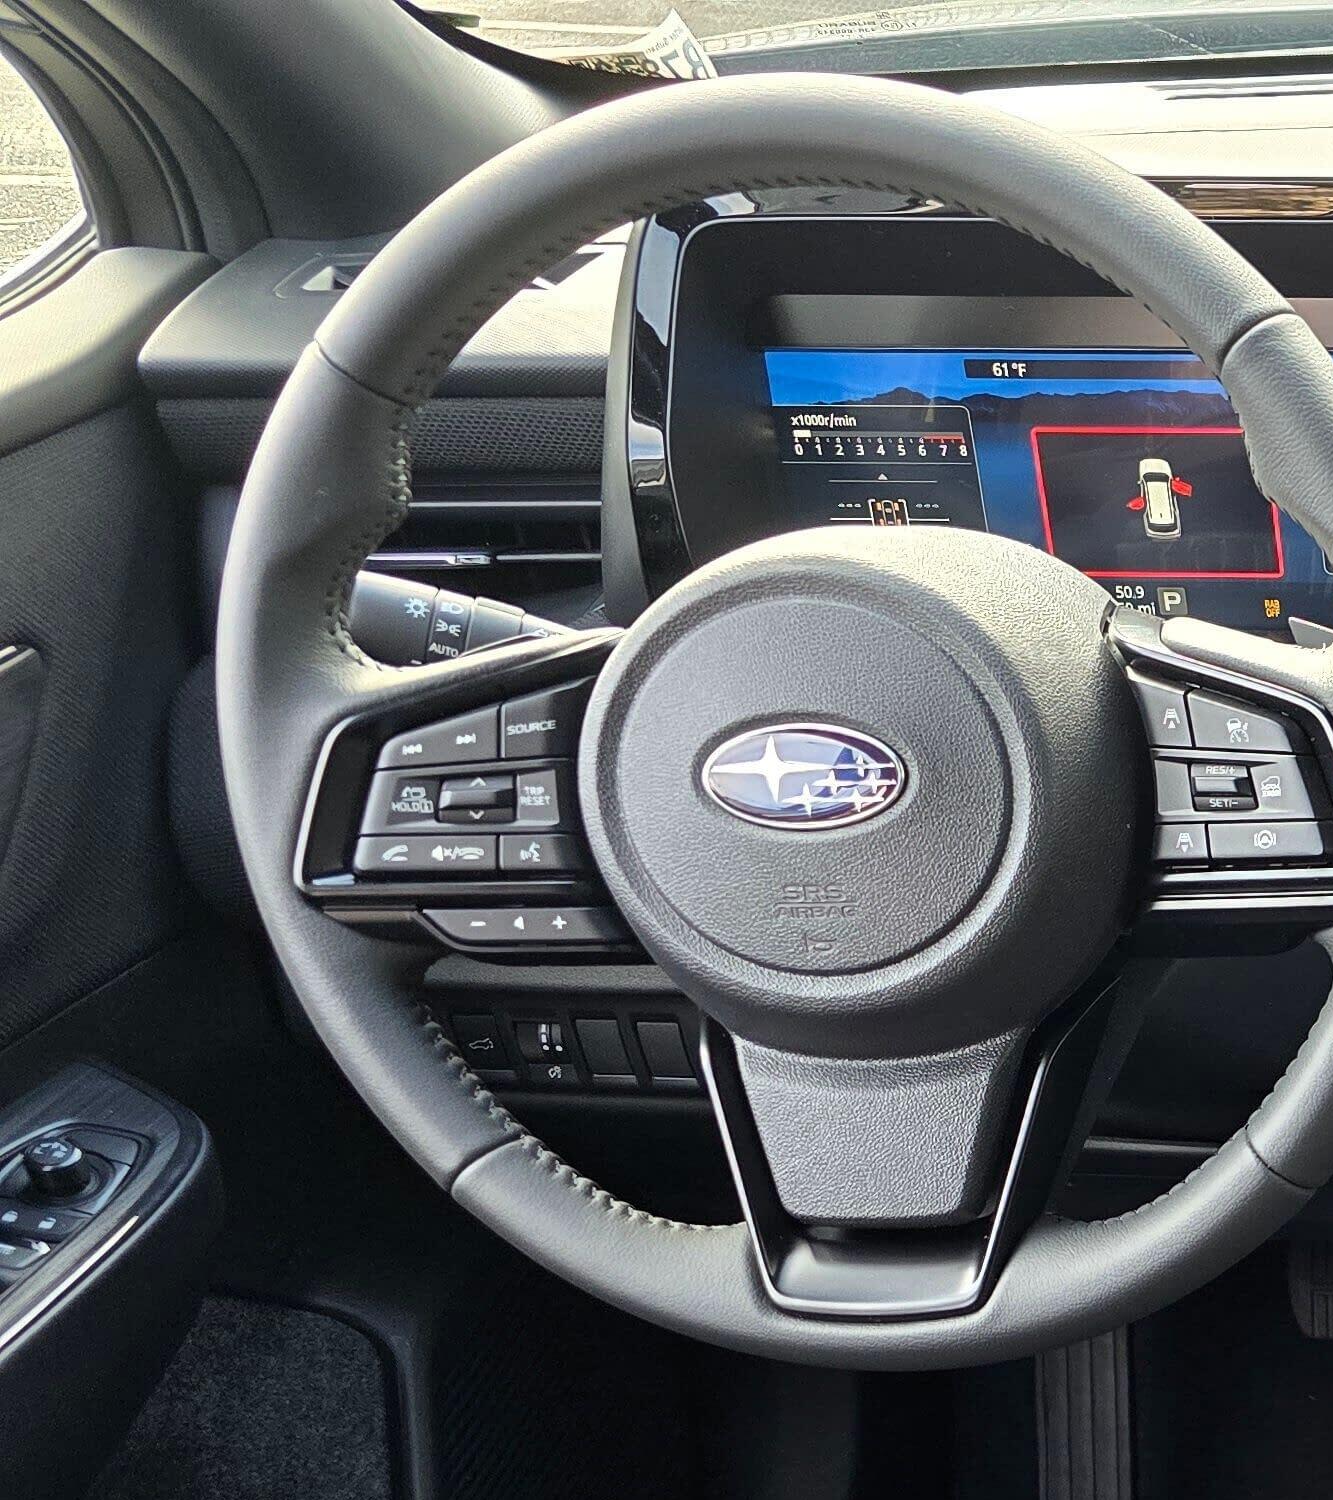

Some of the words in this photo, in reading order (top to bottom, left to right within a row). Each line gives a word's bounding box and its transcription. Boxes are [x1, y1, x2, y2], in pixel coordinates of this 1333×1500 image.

[992, 363, 1026, 377] 61°F
[795, 445, 803, 456] 0
[816, 445, 822, 456] 1
[835, 445, 844, 456] 2
[856, 445, 864, 456] 3
[876, 445, 885, 456] 4
[898, 445, 906, 456] 5
[919, 445, 927, 456] 6
[940, 445, 947, 456] 7
[960, 445, 968, 456] 8
[1116, 586, 1144, 598] 50.9
[1164, 592, 1181, 611] P
[429, 642, 459, 658] AUTO
[507, 720, 556, 736] SOURCE
[524, 786, 544, 796] TRIP
[391, 801, 419, 812] HOLD
[519, 795, 550, 806] RESET
[781, 884, 845, 900] SRS
[774, 906, 857, 918] AIRBAG
